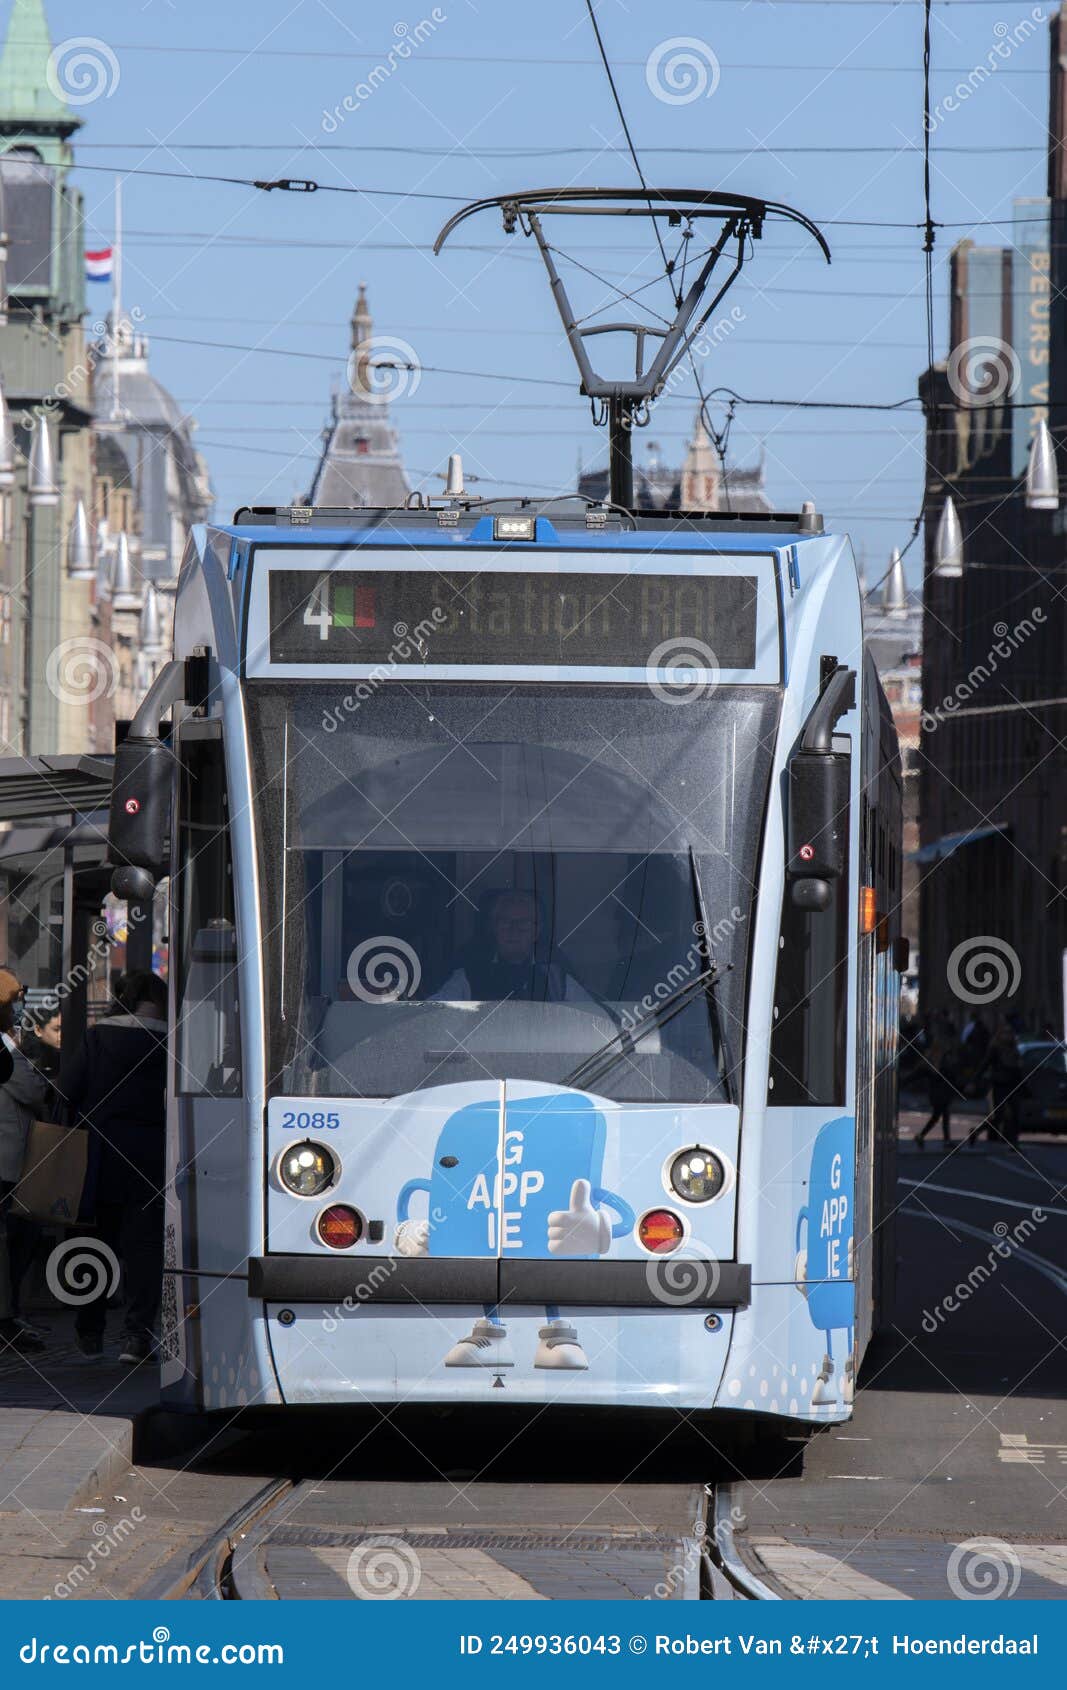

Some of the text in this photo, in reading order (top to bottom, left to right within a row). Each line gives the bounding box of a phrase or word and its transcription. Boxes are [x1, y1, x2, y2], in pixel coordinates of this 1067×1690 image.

[1029, 250, 1050, 438] BEURS VA
[303, 574, 332, 641] 4
[281, 1111, 341, 1131] 2085
[496, 1130, 524, 1166] G
[466, 1170, 545, 1210] APP
[830, 1153, 841, 1190] G
[487, 1211, 523, 1250] IE
[820, 1195, 848, 1238] APP
[827, 1239, 840, 1278] IE
